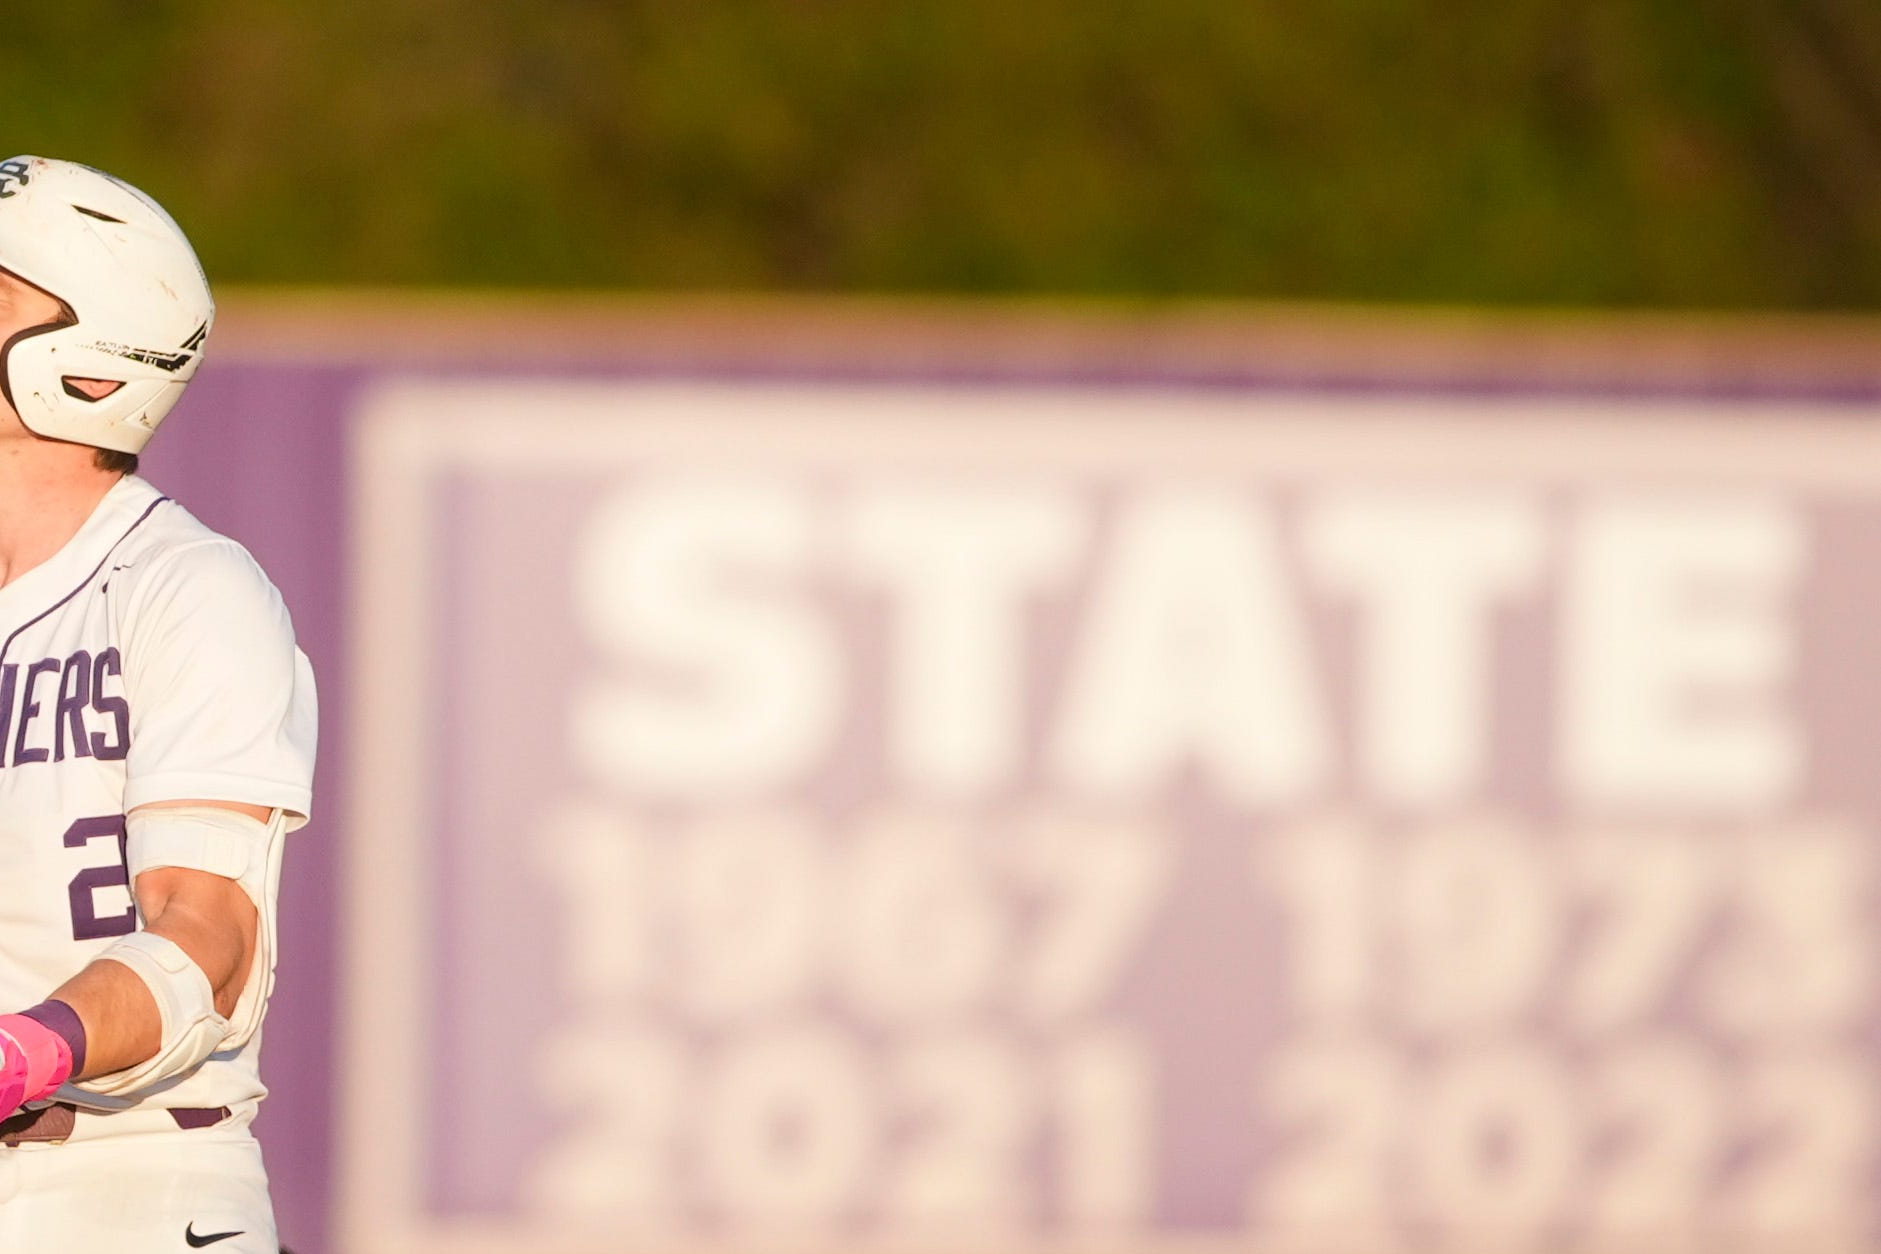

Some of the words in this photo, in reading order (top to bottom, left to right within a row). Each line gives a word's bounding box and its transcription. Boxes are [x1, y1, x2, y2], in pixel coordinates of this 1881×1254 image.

[572, 476, 1806, 808] STATE
[62, 813, 137, 941] 2
[542, 806, 1160, 1020] 1967
[524, 1018, 1156, 1236] 2021
[1254, 1034, 1878, 1250] 2022
